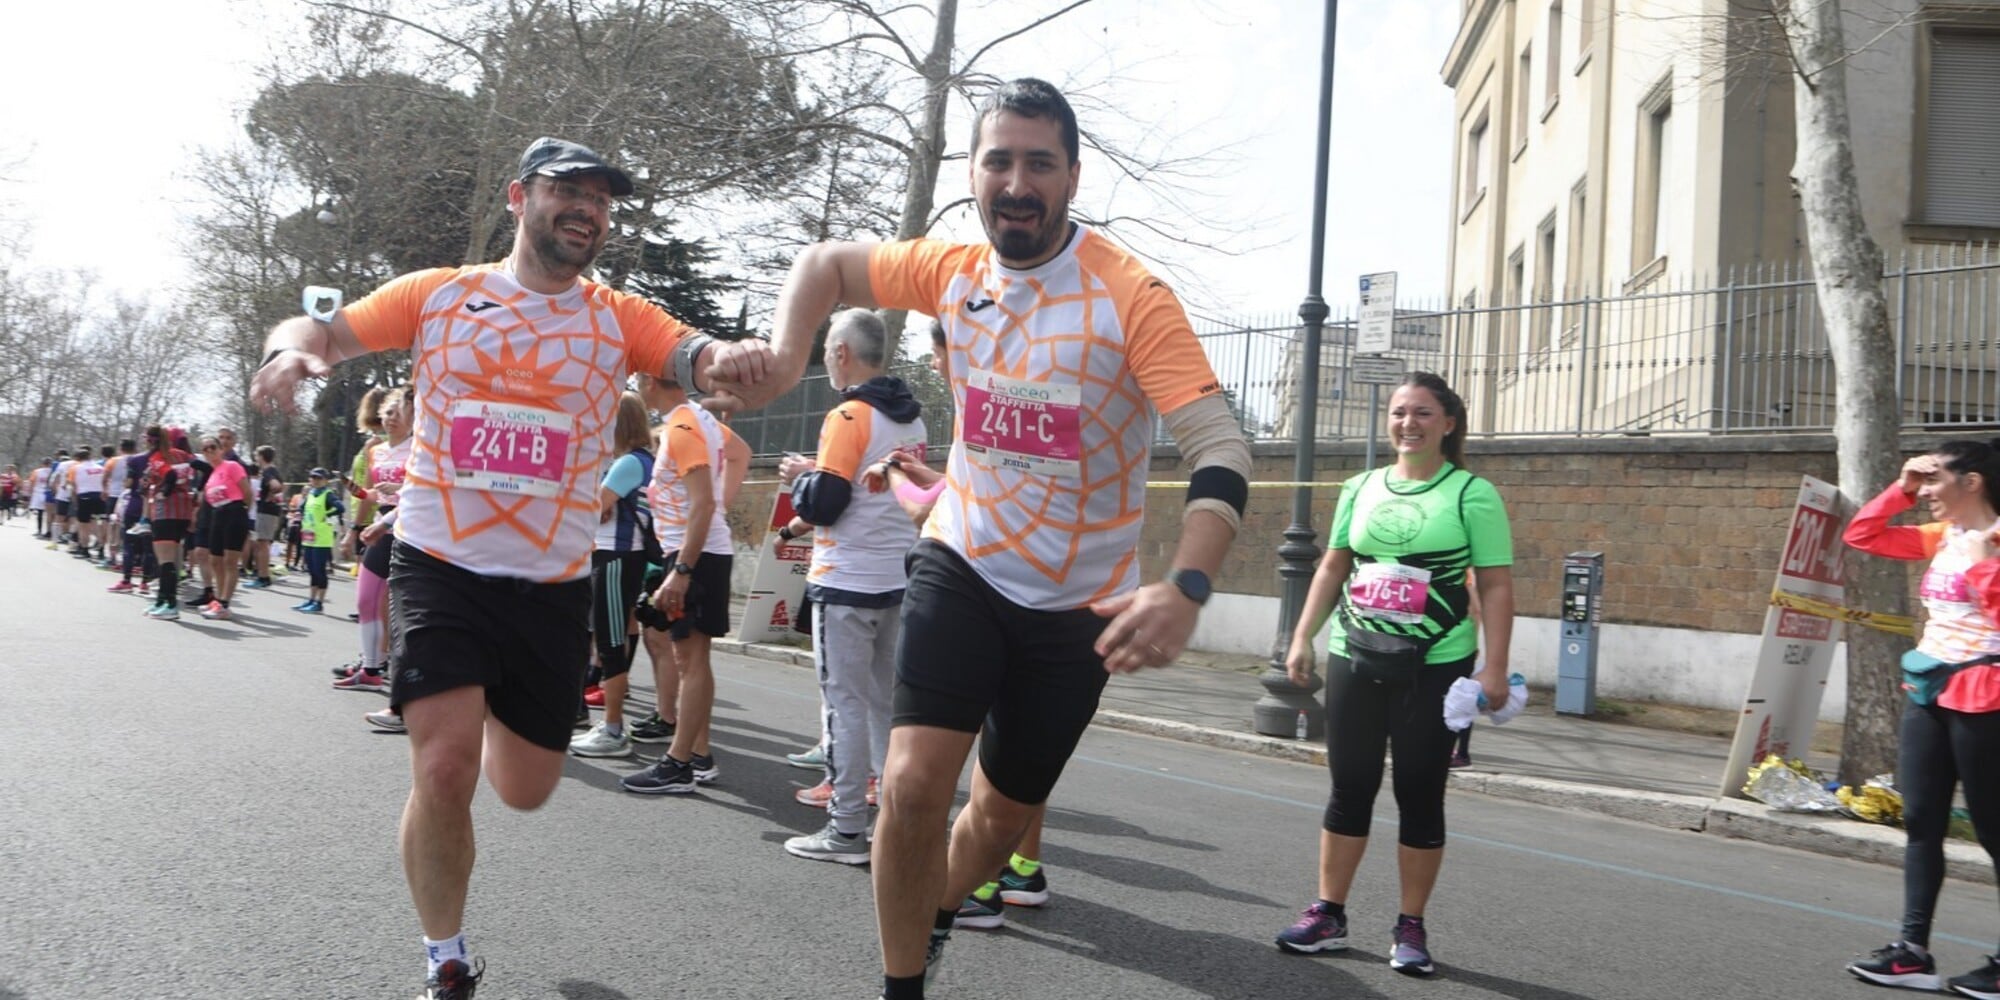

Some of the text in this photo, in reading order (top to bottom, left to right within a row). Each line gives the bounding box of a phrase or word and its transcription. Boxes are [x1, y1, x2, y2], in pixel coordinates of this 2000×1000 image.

[1009, 386, 1049, 400] acea
[990, 393, 1046, 412] STAFFETTA
[507, 411, 546, 424] acea
[981, 401, 1055, 443] 241-C
[483, 419, 543, 434] STAFFETTA
[470, 426, 548, 465] 241-B
